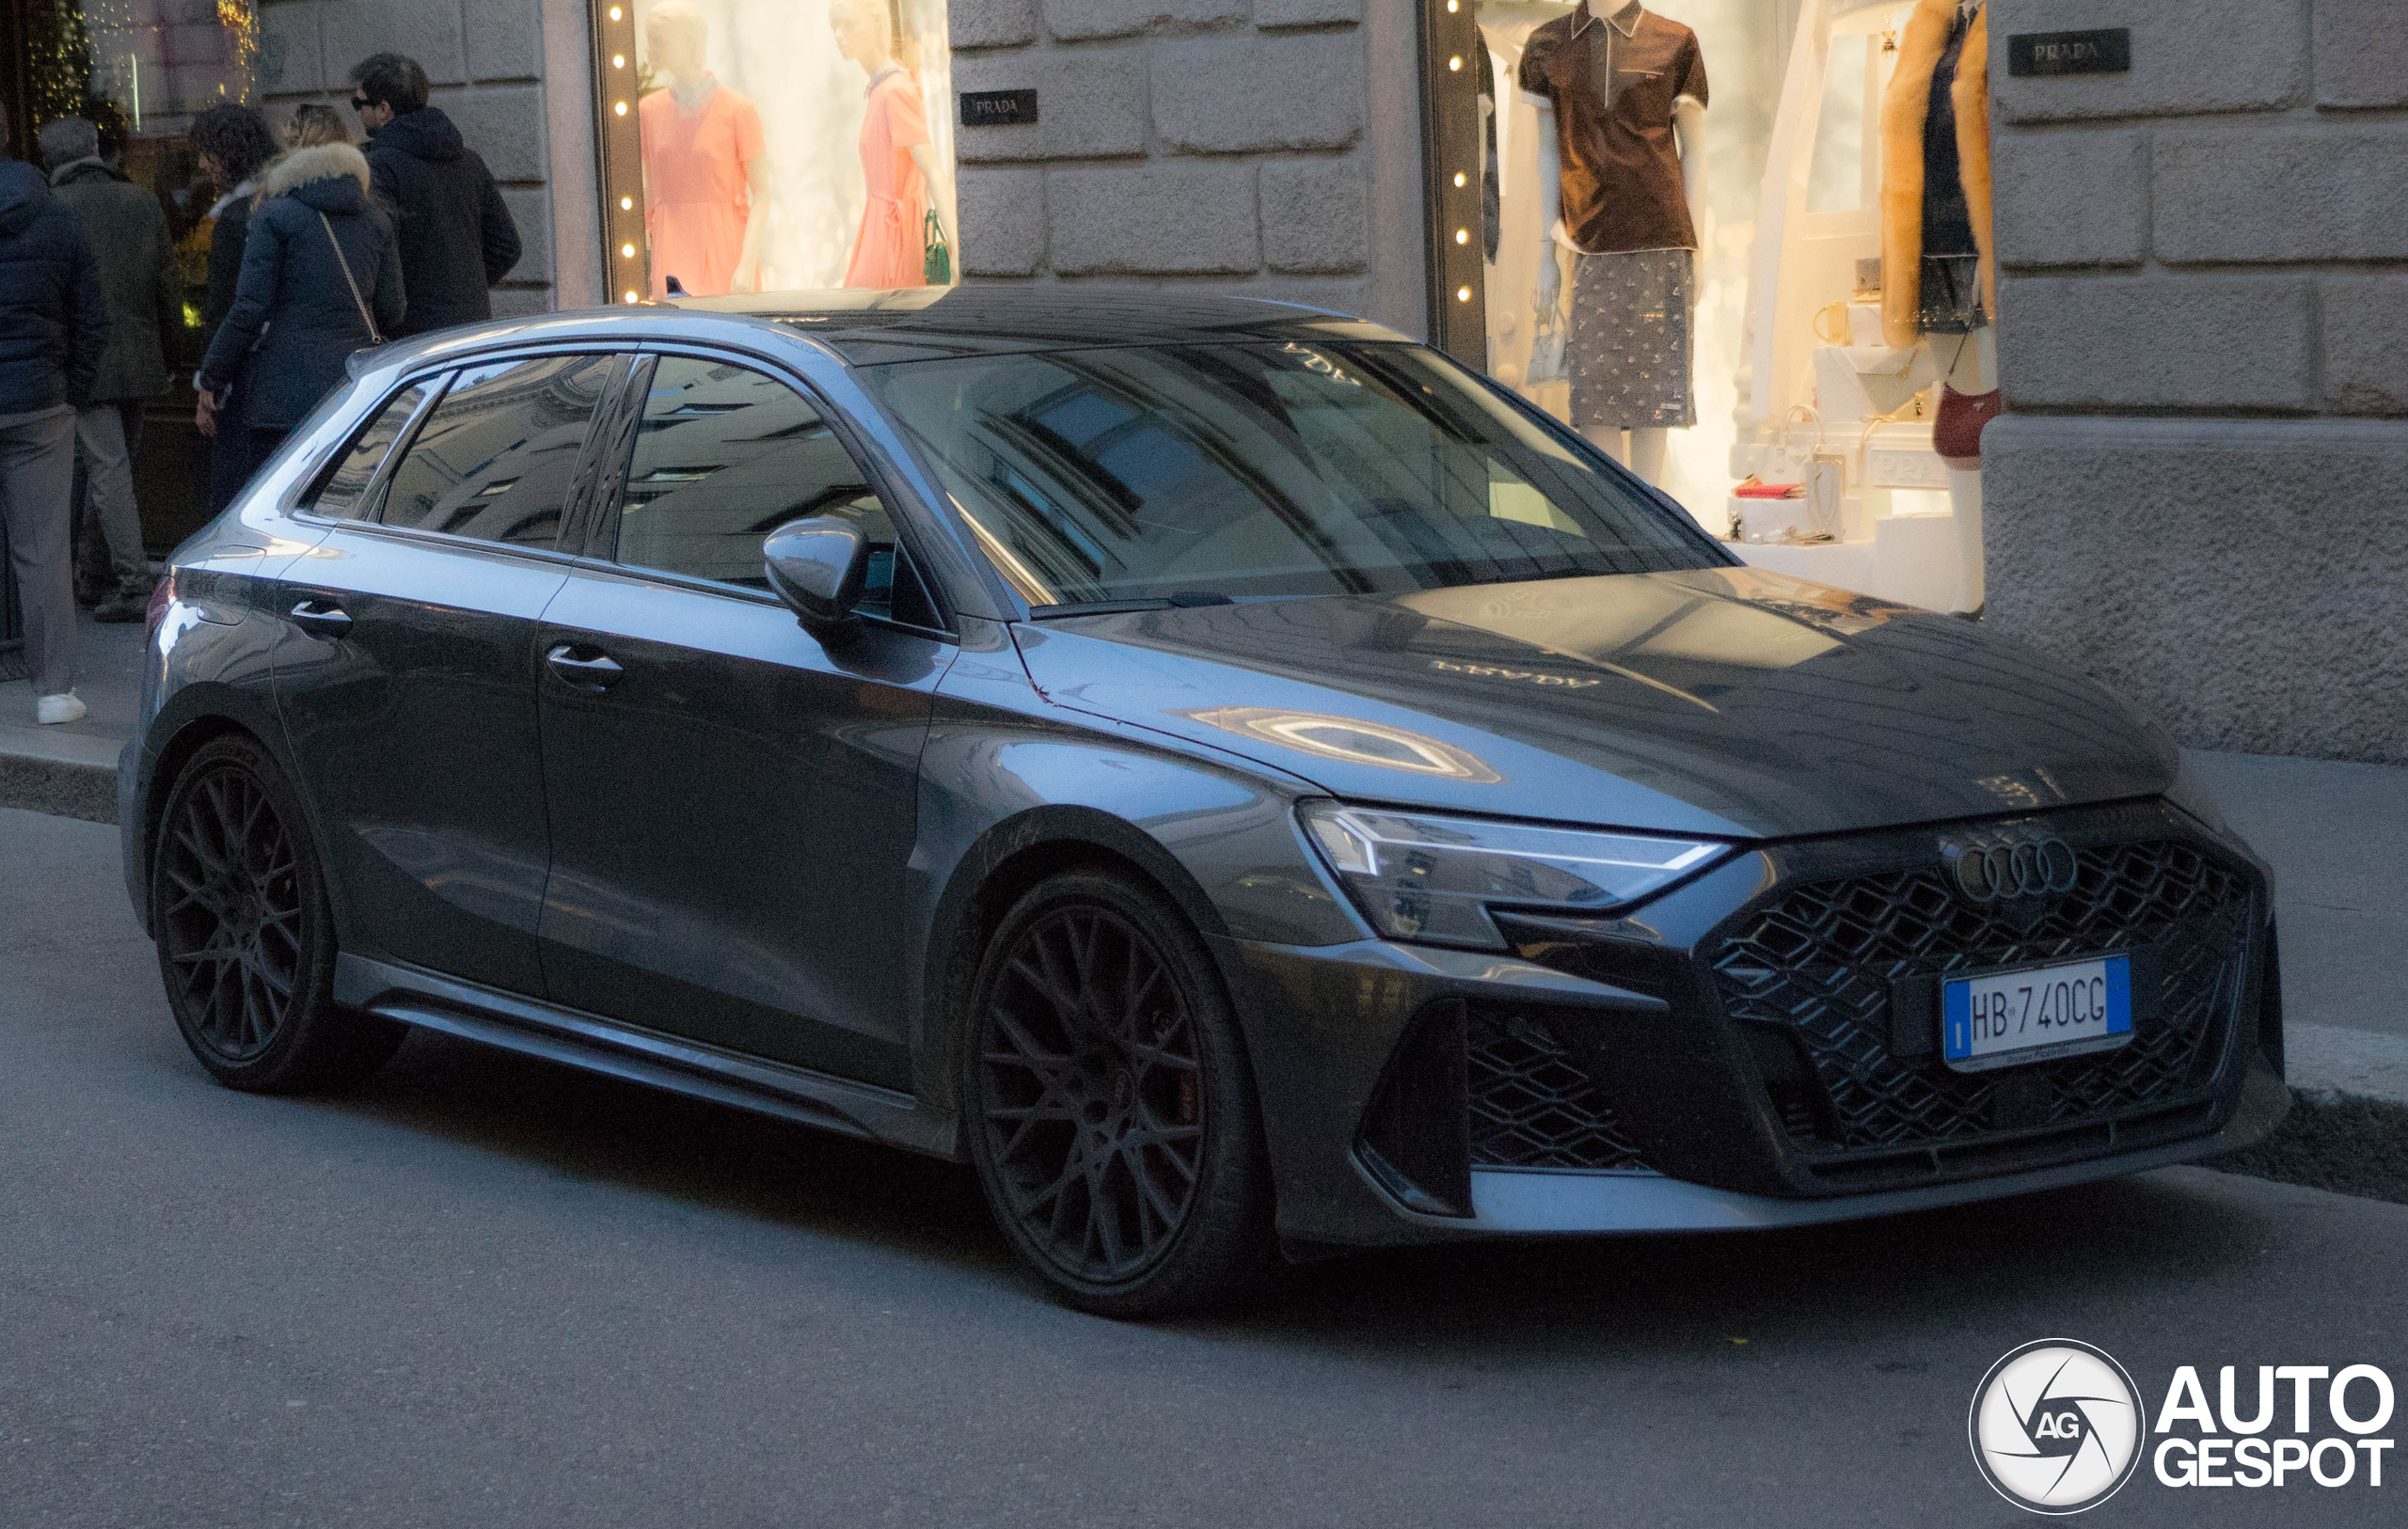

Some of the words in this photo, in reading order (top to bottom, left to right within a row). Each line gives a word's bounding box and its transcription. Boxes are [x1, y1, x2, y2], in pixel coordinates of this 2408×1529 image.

[2035, 41, 2098, 61] PRADA
[975, 100, 1018, 114] PRADA
[1972, 991, 2007, 1041] HB
[2019, 976, 2104, 1033] 740CG
